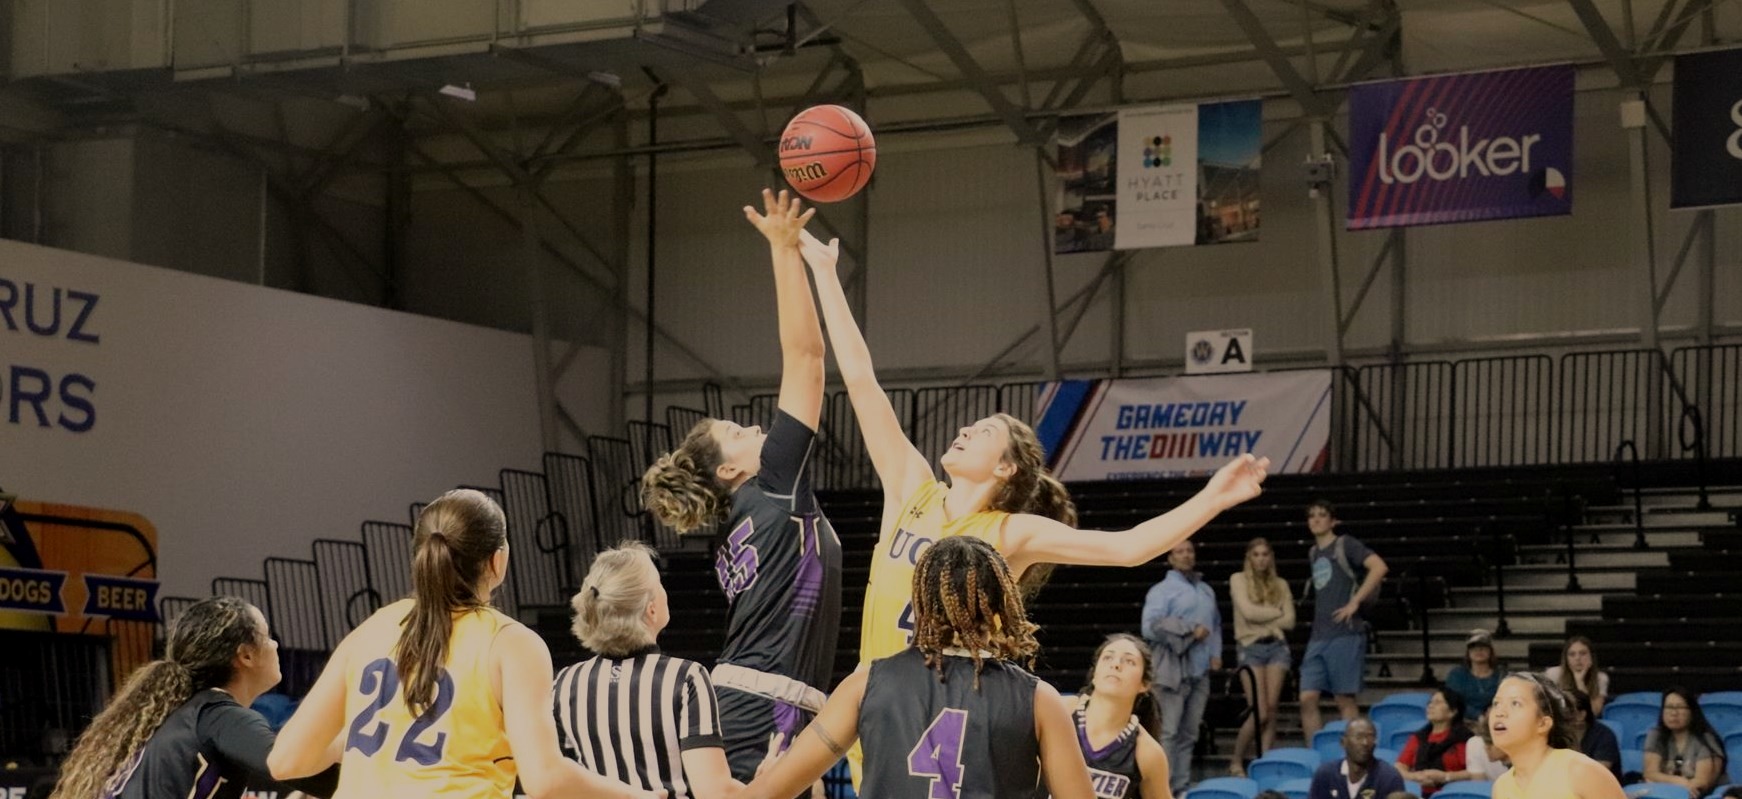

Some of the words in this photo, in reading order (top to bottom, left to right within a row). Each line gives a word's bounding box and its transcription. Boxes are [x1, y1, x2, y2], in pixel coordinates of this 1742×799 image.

[1379, 108, 1540, 184] looker
[1128, 174, 1183, 190] HYATT
[1136, 189, 1177, 203] PLACE
[1221, 338, 1246, 364] A
[0, 364, 96, 433] RS
[1116, 401, 1247, 430] GAMEDAY
[97, 585, 148, 610] BEER
[345, 657, 455, 766] 22
[907, 707, 968, 799] 4
